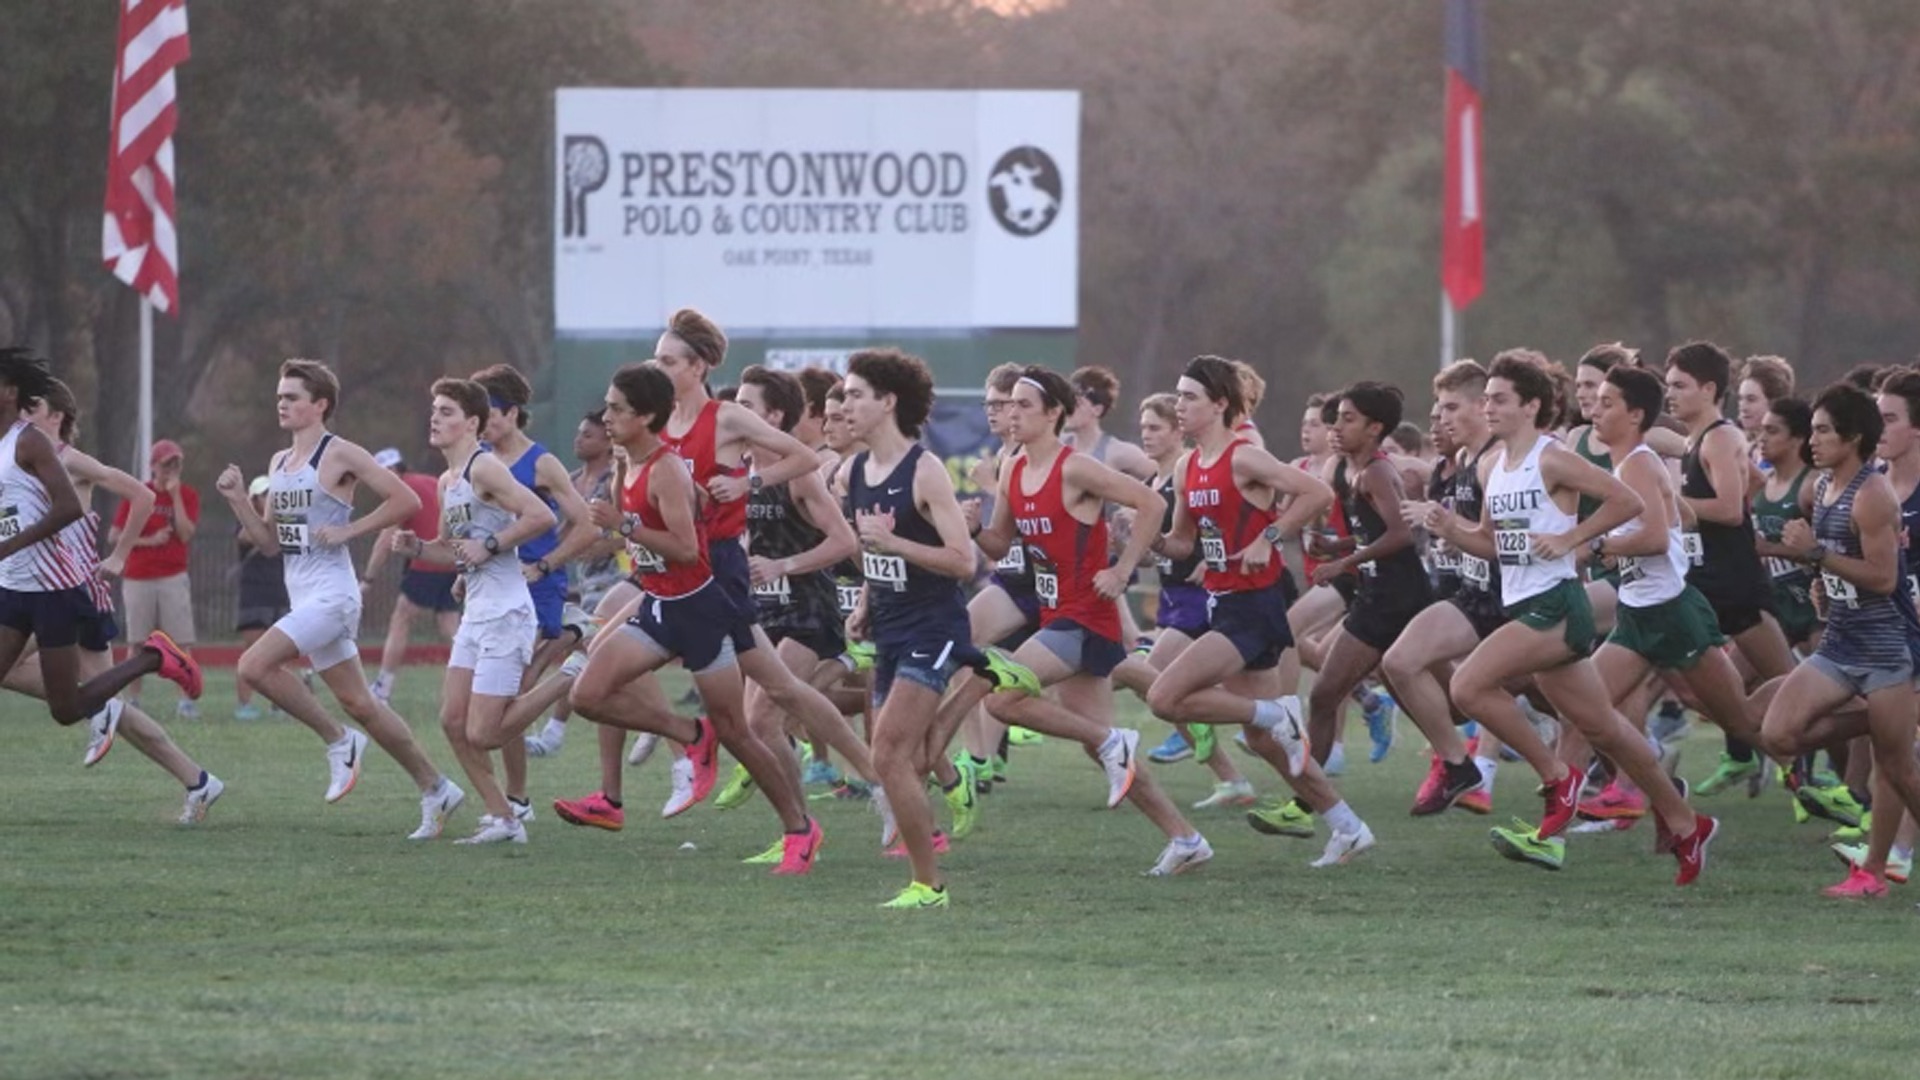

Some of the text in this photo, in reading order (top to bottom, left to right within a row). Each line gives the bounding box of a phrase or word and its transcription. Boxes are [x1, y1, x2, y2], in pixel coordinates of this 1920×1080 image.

[620, 152, 968, 198] PRESTONWOOD
[623, 203, 968, 237] POLO & COUNTRY CLUB
[723, 248, 757, 267] OAK
[823, 248, 874, 267] TEXAS
[271, 488, 314, 511] ESUIT
[1188, 488, 1220, 508] BOYD
[865, 556, 901, 578] 1121
